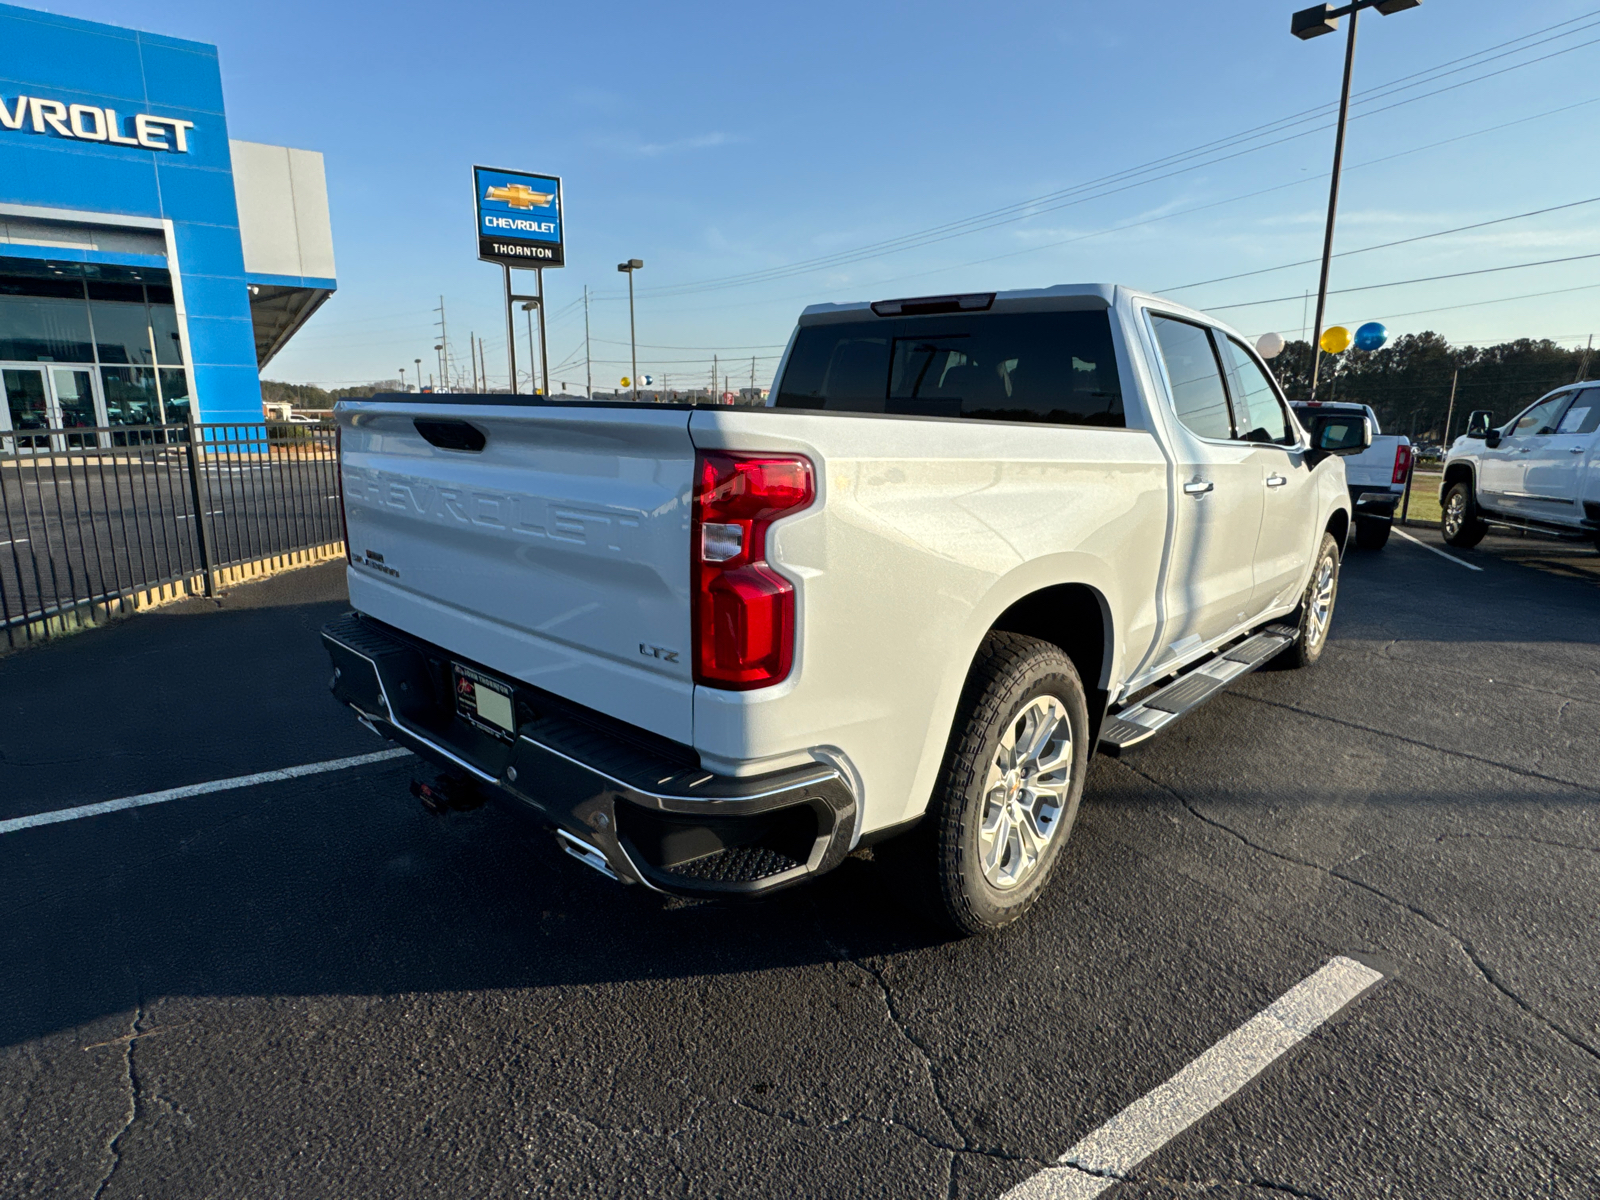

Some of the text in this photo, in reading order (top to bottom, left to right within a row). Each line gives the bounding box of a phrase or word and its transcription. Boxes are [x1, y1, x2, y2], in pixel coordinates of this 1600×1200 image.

[0, 95, 194, 152] VROLET
[485, 216, 556, 233] CHEVROLET
[493, 243, 553, 259] THORNTON
[345, 472, 640, 552] CHEVROLET
[639, 641, 680, 664] LTZ
